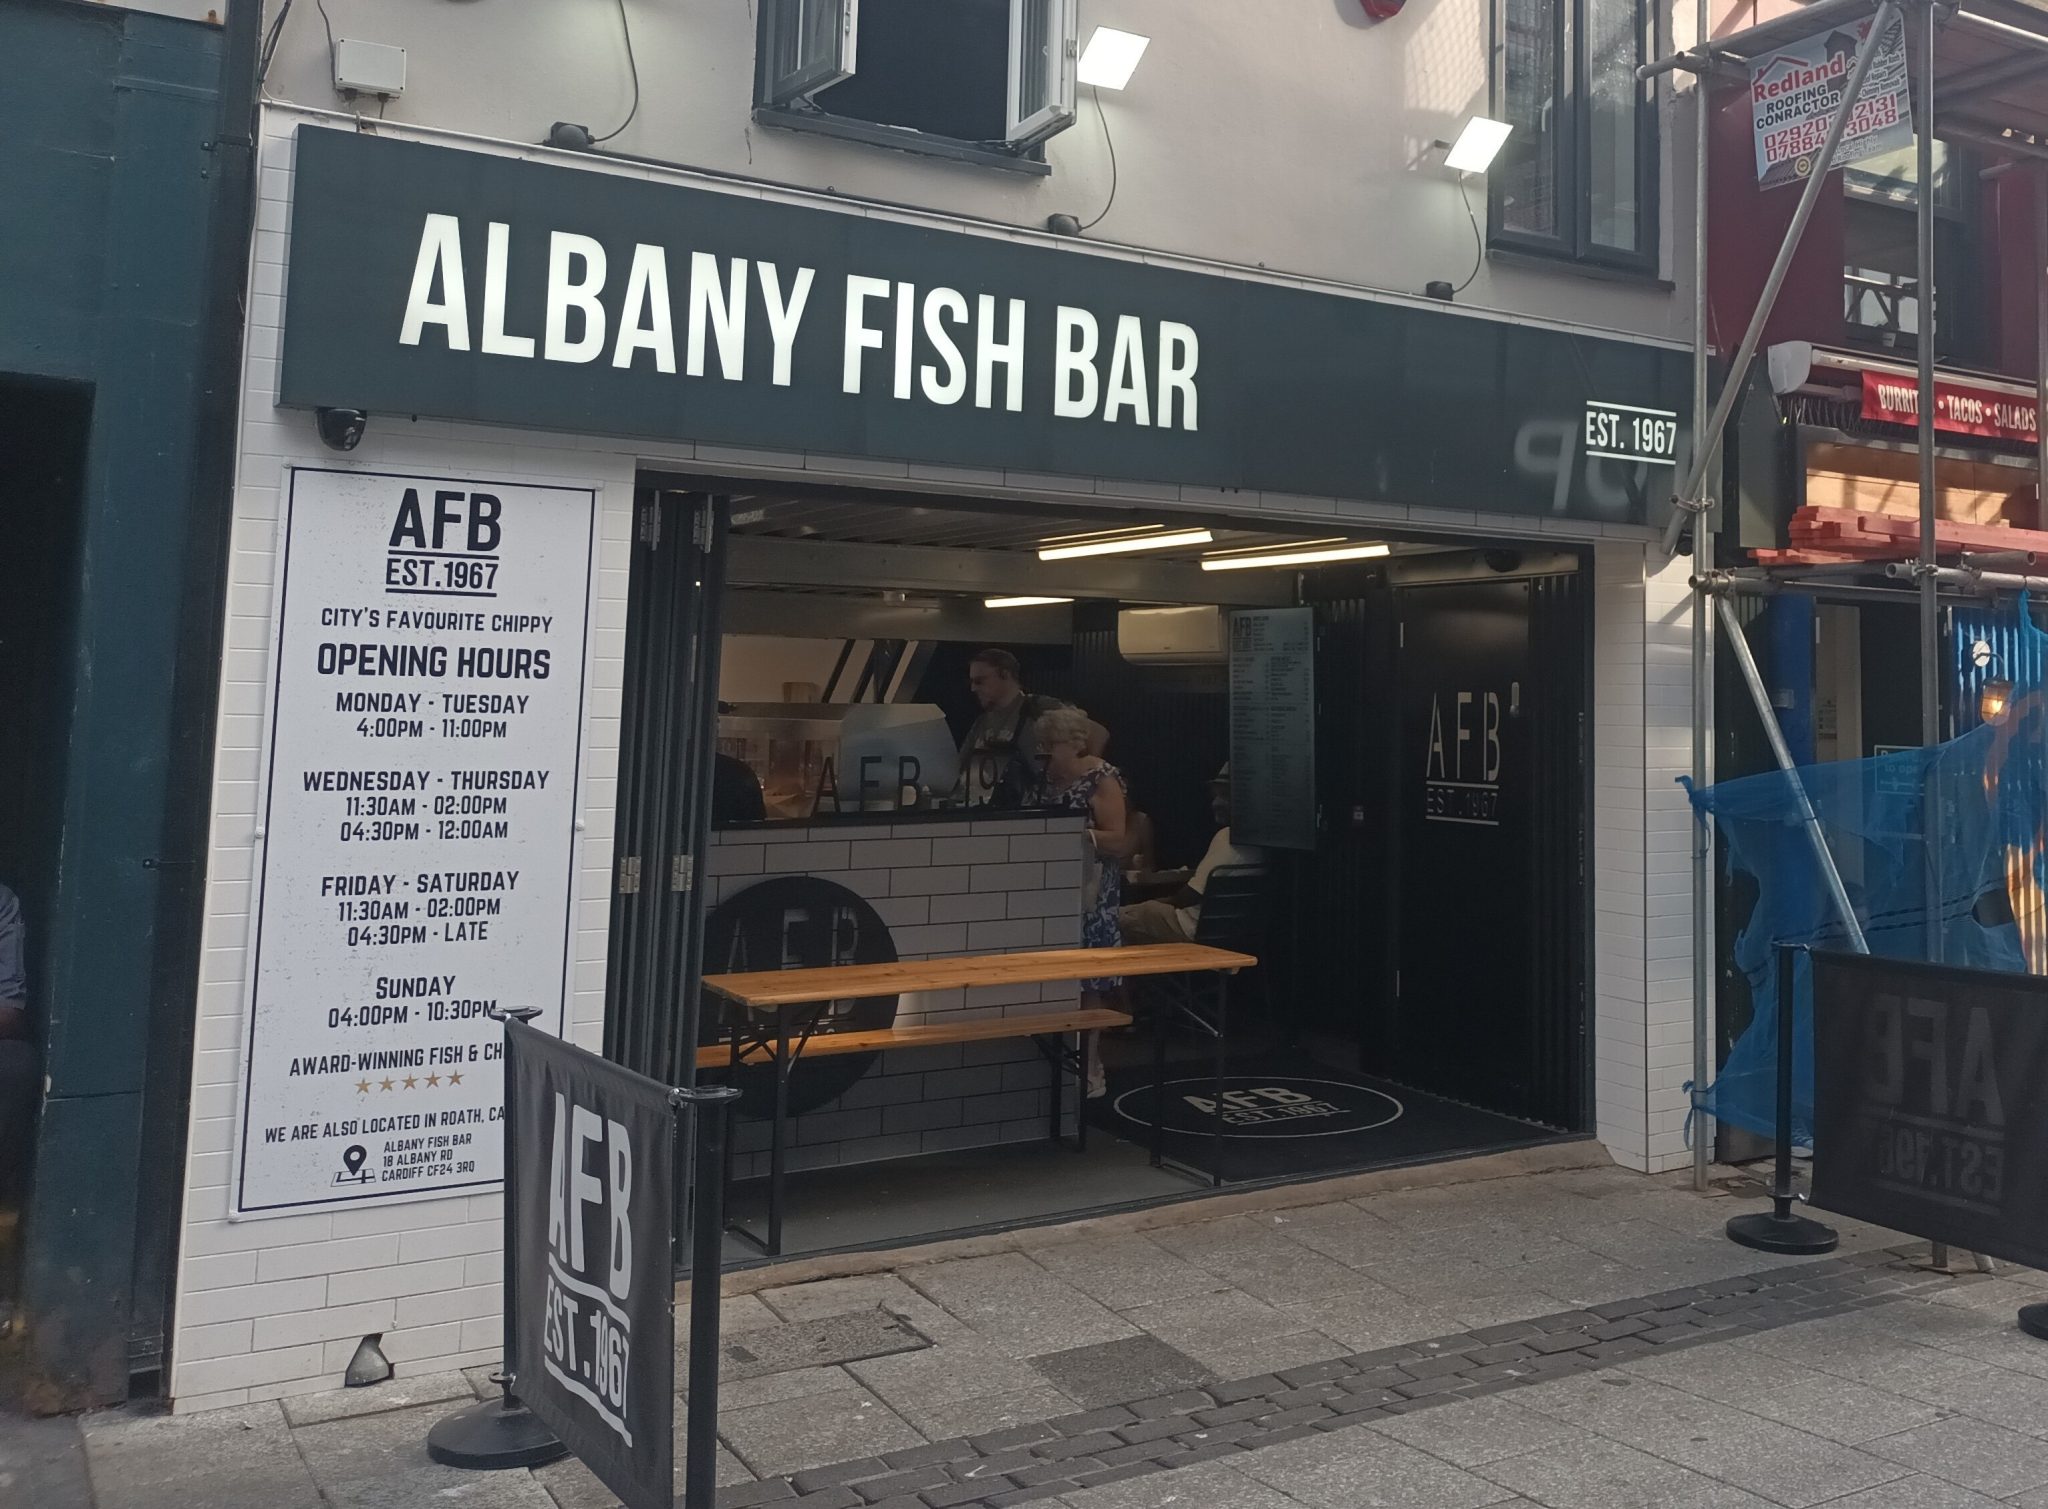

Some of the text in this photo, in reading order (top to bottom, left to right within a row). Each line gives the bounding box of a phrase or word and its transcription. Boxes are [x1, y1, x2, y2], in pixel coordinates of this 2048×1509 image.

[1753, 51, 1843, 103] Redland
[1756, 92, 1840, 129] CONRACTOR
[1766, 84, 1827, 114] ROOFING
[1764, 94, 1896, 149] 029202131
[1767, 109, 1897, 162] 078843048
[400, 214, 1198, 430] ALBANY FISH BAR
[1878, 383, 2037, 432] BURRIT TACOS SALADS
[1587, 412, 1676, 453] EST. 1967
[388, 488, 501, 551] AFB
[386, 558, 498, 589] EST.1967
[322, 607, 552, 633] CITY'S FAVOURITE CHIPPY
[318, 643, 550, 679] OPENING HOURS
[336, 693, 421, 712] MONDAY
[443, 694, 529, 713] TUESDAY
[357, 718, 422, 737] 4:00PM
[443, 719, 506, 737] 11:00PM
[1426, 691, 1500, 782] AFB
[304, 771, 430, 791] WEDNESDAY
[451, 771, 549, 790] THURSDAY
[347, 797, 415, 816] 11:30AM
[434, 796, 506, 814] 02:00PM
[341, 822, 419, 841] 04:30PM
[439, 820, 507, 839] 12:00AM
[322, 875, 396, 896] FRIDAY
[417, 871, 519, 893] SATURDAY
[339, 901, 408, 921] 11:30AM
[428, 897, 500, 917] 02:00PM
[348, 925, 426, 946] 04:30PM
[445, 921, 488, 941] LATE
[376, 976, 455, 999] SUNDAY
[329, 1006, 408, 1028] 04:00PM
[427, 999, 496, 1021] 10:30PM
[290, 1041, 505, 1076] AWARD-WINNING FISH & CH
[1182, 1087, 1313, 1113] AFB
[266, 1105, 504, 1143] WE ARE ALSO LOCATED IN ROATH, CA
[384, 1133, 471, 1152] ALBANY FISH BAR
[382, 1161, 474, 1181] CARDIFF CF24 3RQ
[384, 1149, 452, 1167] 18 ALBANY RD
[549, 1091, 632, 1300] AFB
